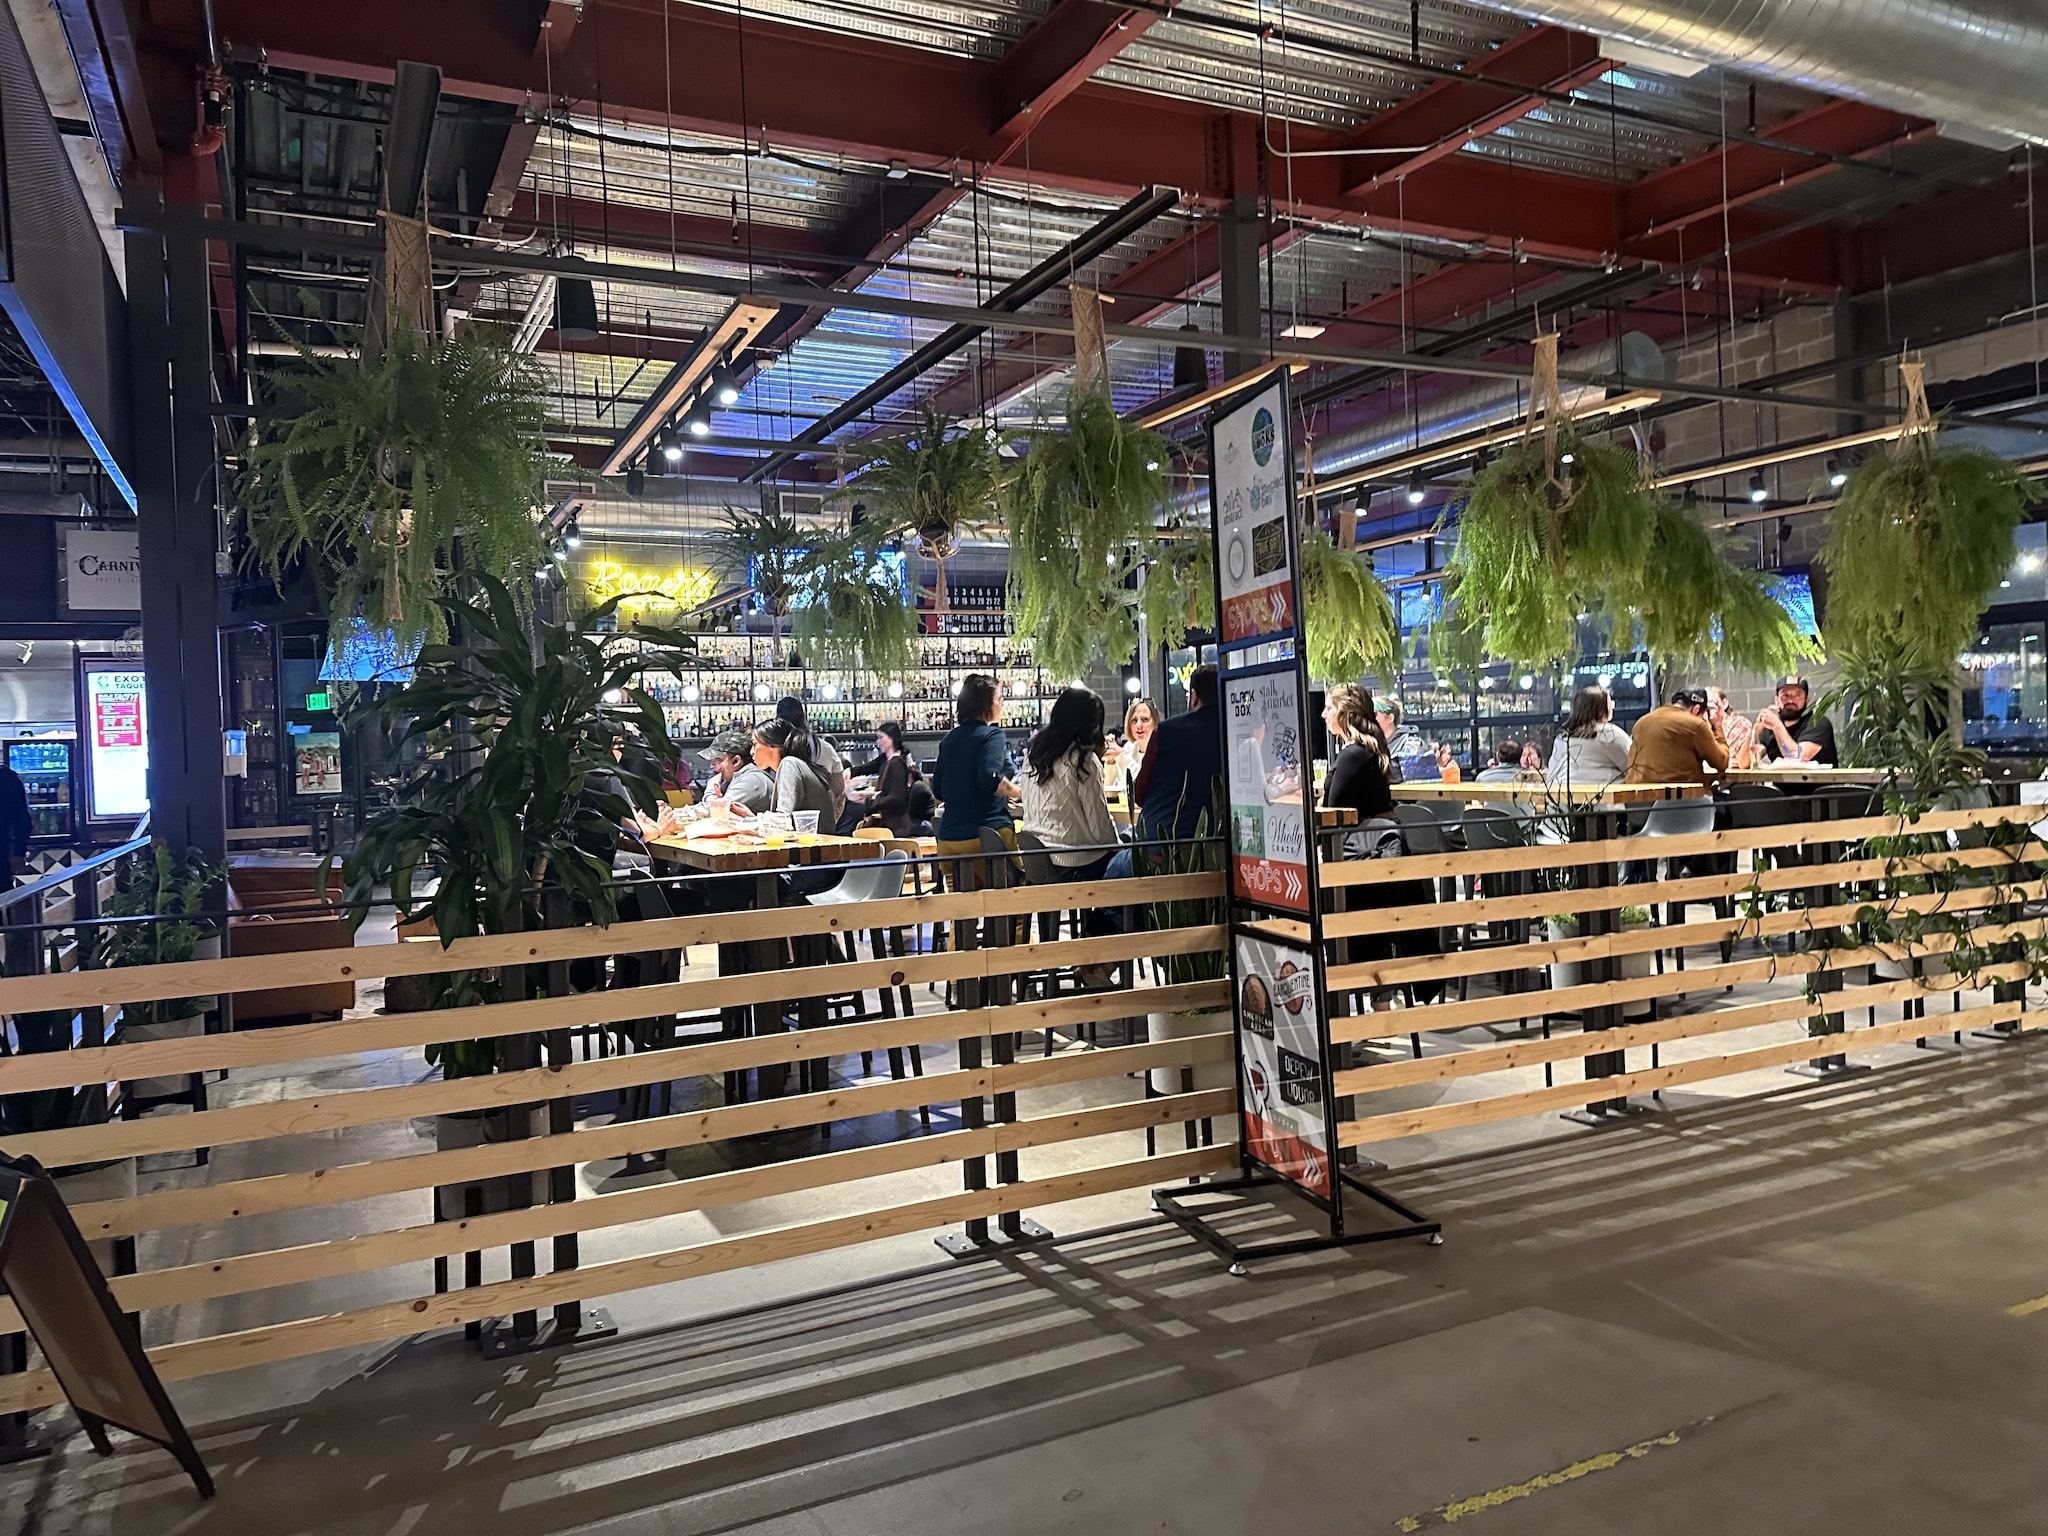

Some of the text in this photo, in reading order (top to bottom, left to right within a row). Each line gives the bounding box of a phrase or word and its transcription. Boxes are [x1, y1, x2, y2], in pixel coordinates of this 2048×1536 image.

[1228, 597, 1267, 630] SHOPS
[1259, 679, 1278, 698] stalk
[1267, 689, 1294, 710] market
[1235, 704, 1251, 717] BOX
[1267, 813, 1303, 858] Wholly
[1240, 863, 1282, 893] SHOPS
[1243, 1009, 1273, 1027] AMERICAN
[1284, 1054, 1313, 1083] DEPEW
